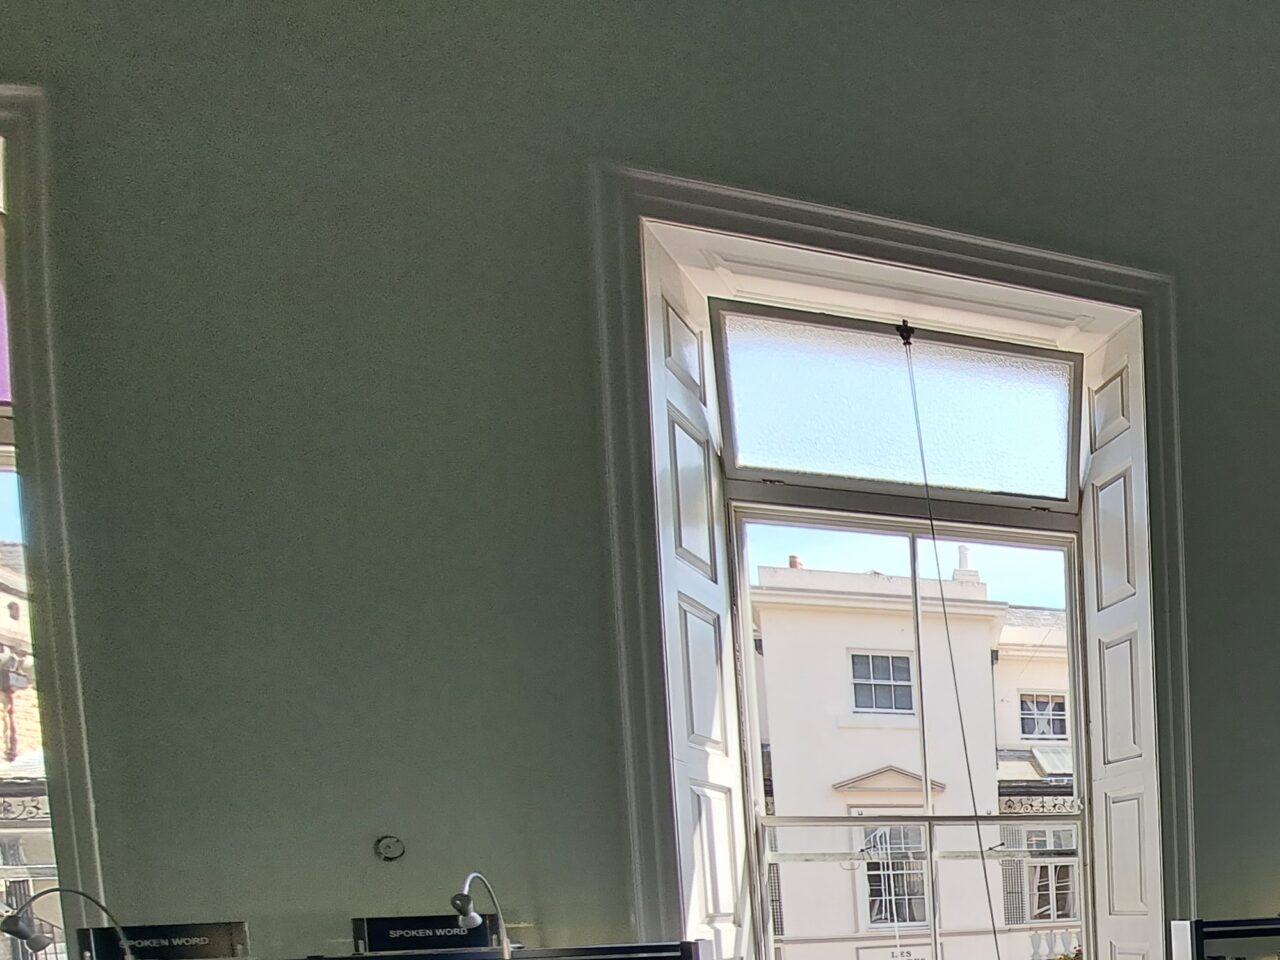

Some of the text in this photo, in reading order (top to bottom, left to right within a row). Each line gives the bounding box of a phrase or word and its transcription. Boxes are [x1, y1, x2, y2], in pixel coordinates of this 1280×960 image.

[389, 927, 468, 938] SPOKEN WORD
[170, 936, 209, 946] WORD
